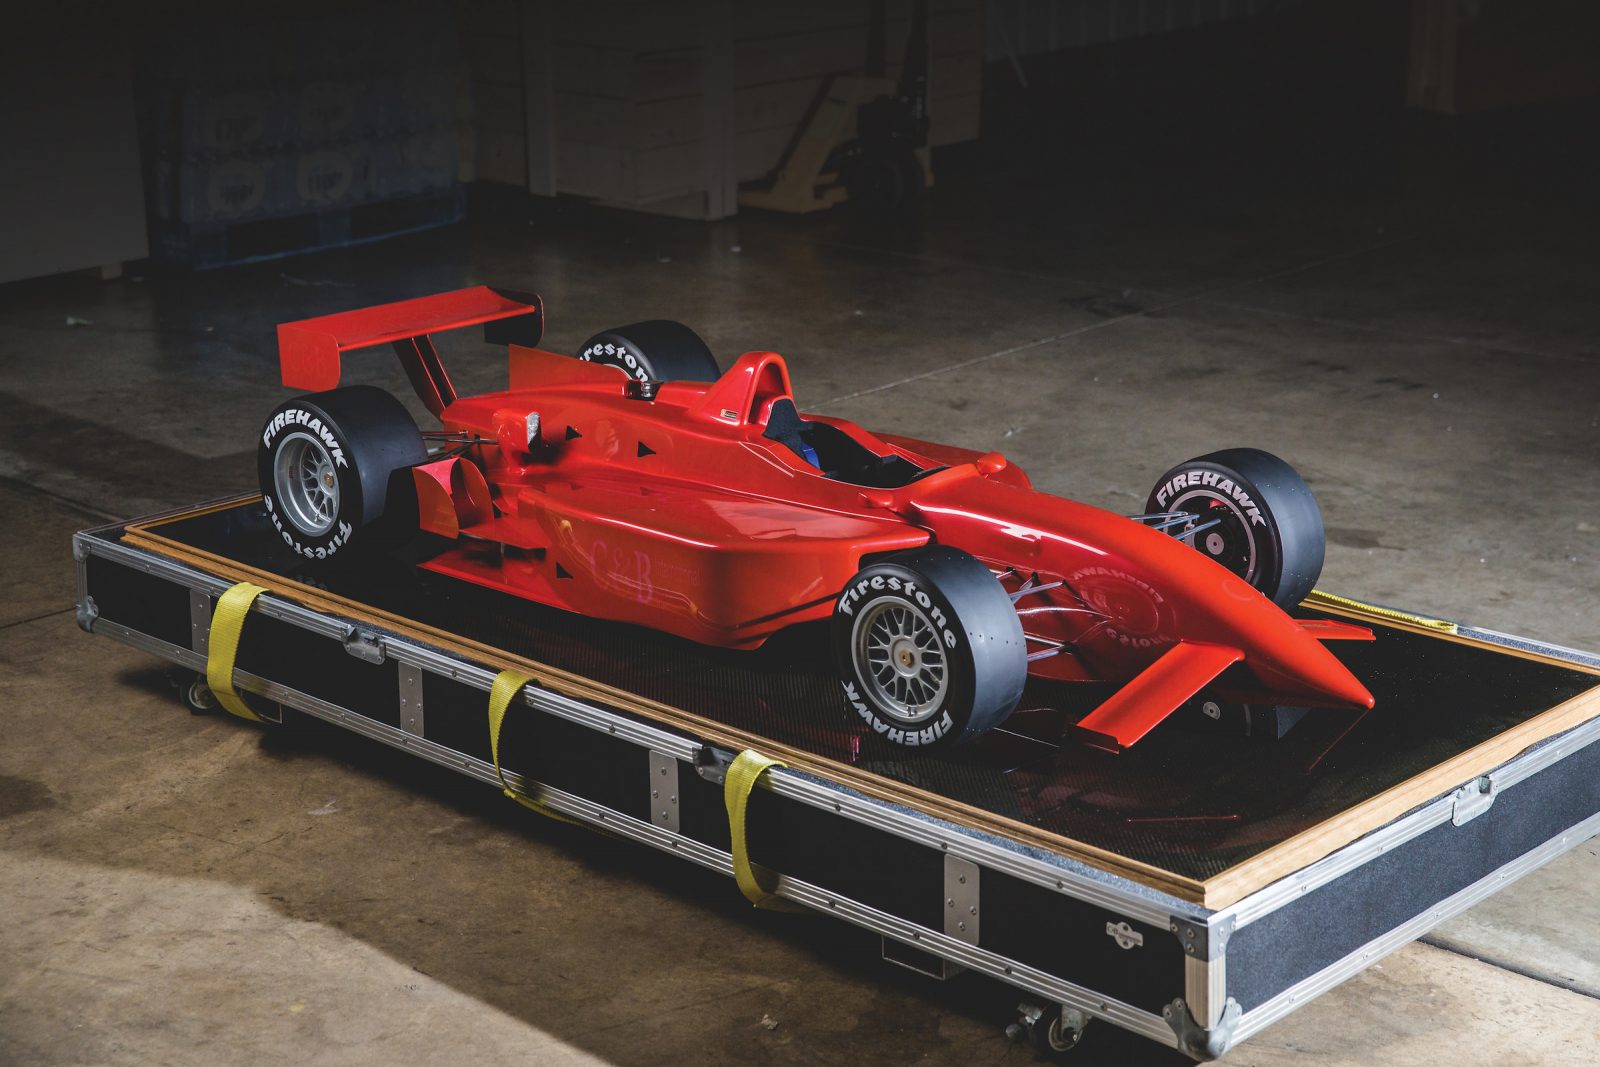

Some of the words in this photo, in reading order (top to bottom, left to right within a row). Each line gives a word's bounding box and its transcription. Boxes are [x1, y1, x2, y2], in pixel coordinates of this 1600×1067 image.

[579, 343, 648, 382] reston
[263, 409, 349, 469] FIREHAWK
[264, 494, 353, 559] Firestone
[1156, 471, 1266, 527] FIREHAWK
[838, 575, 957, 649] Firestone
[841, 680, 954, 746] FIREHAWK
